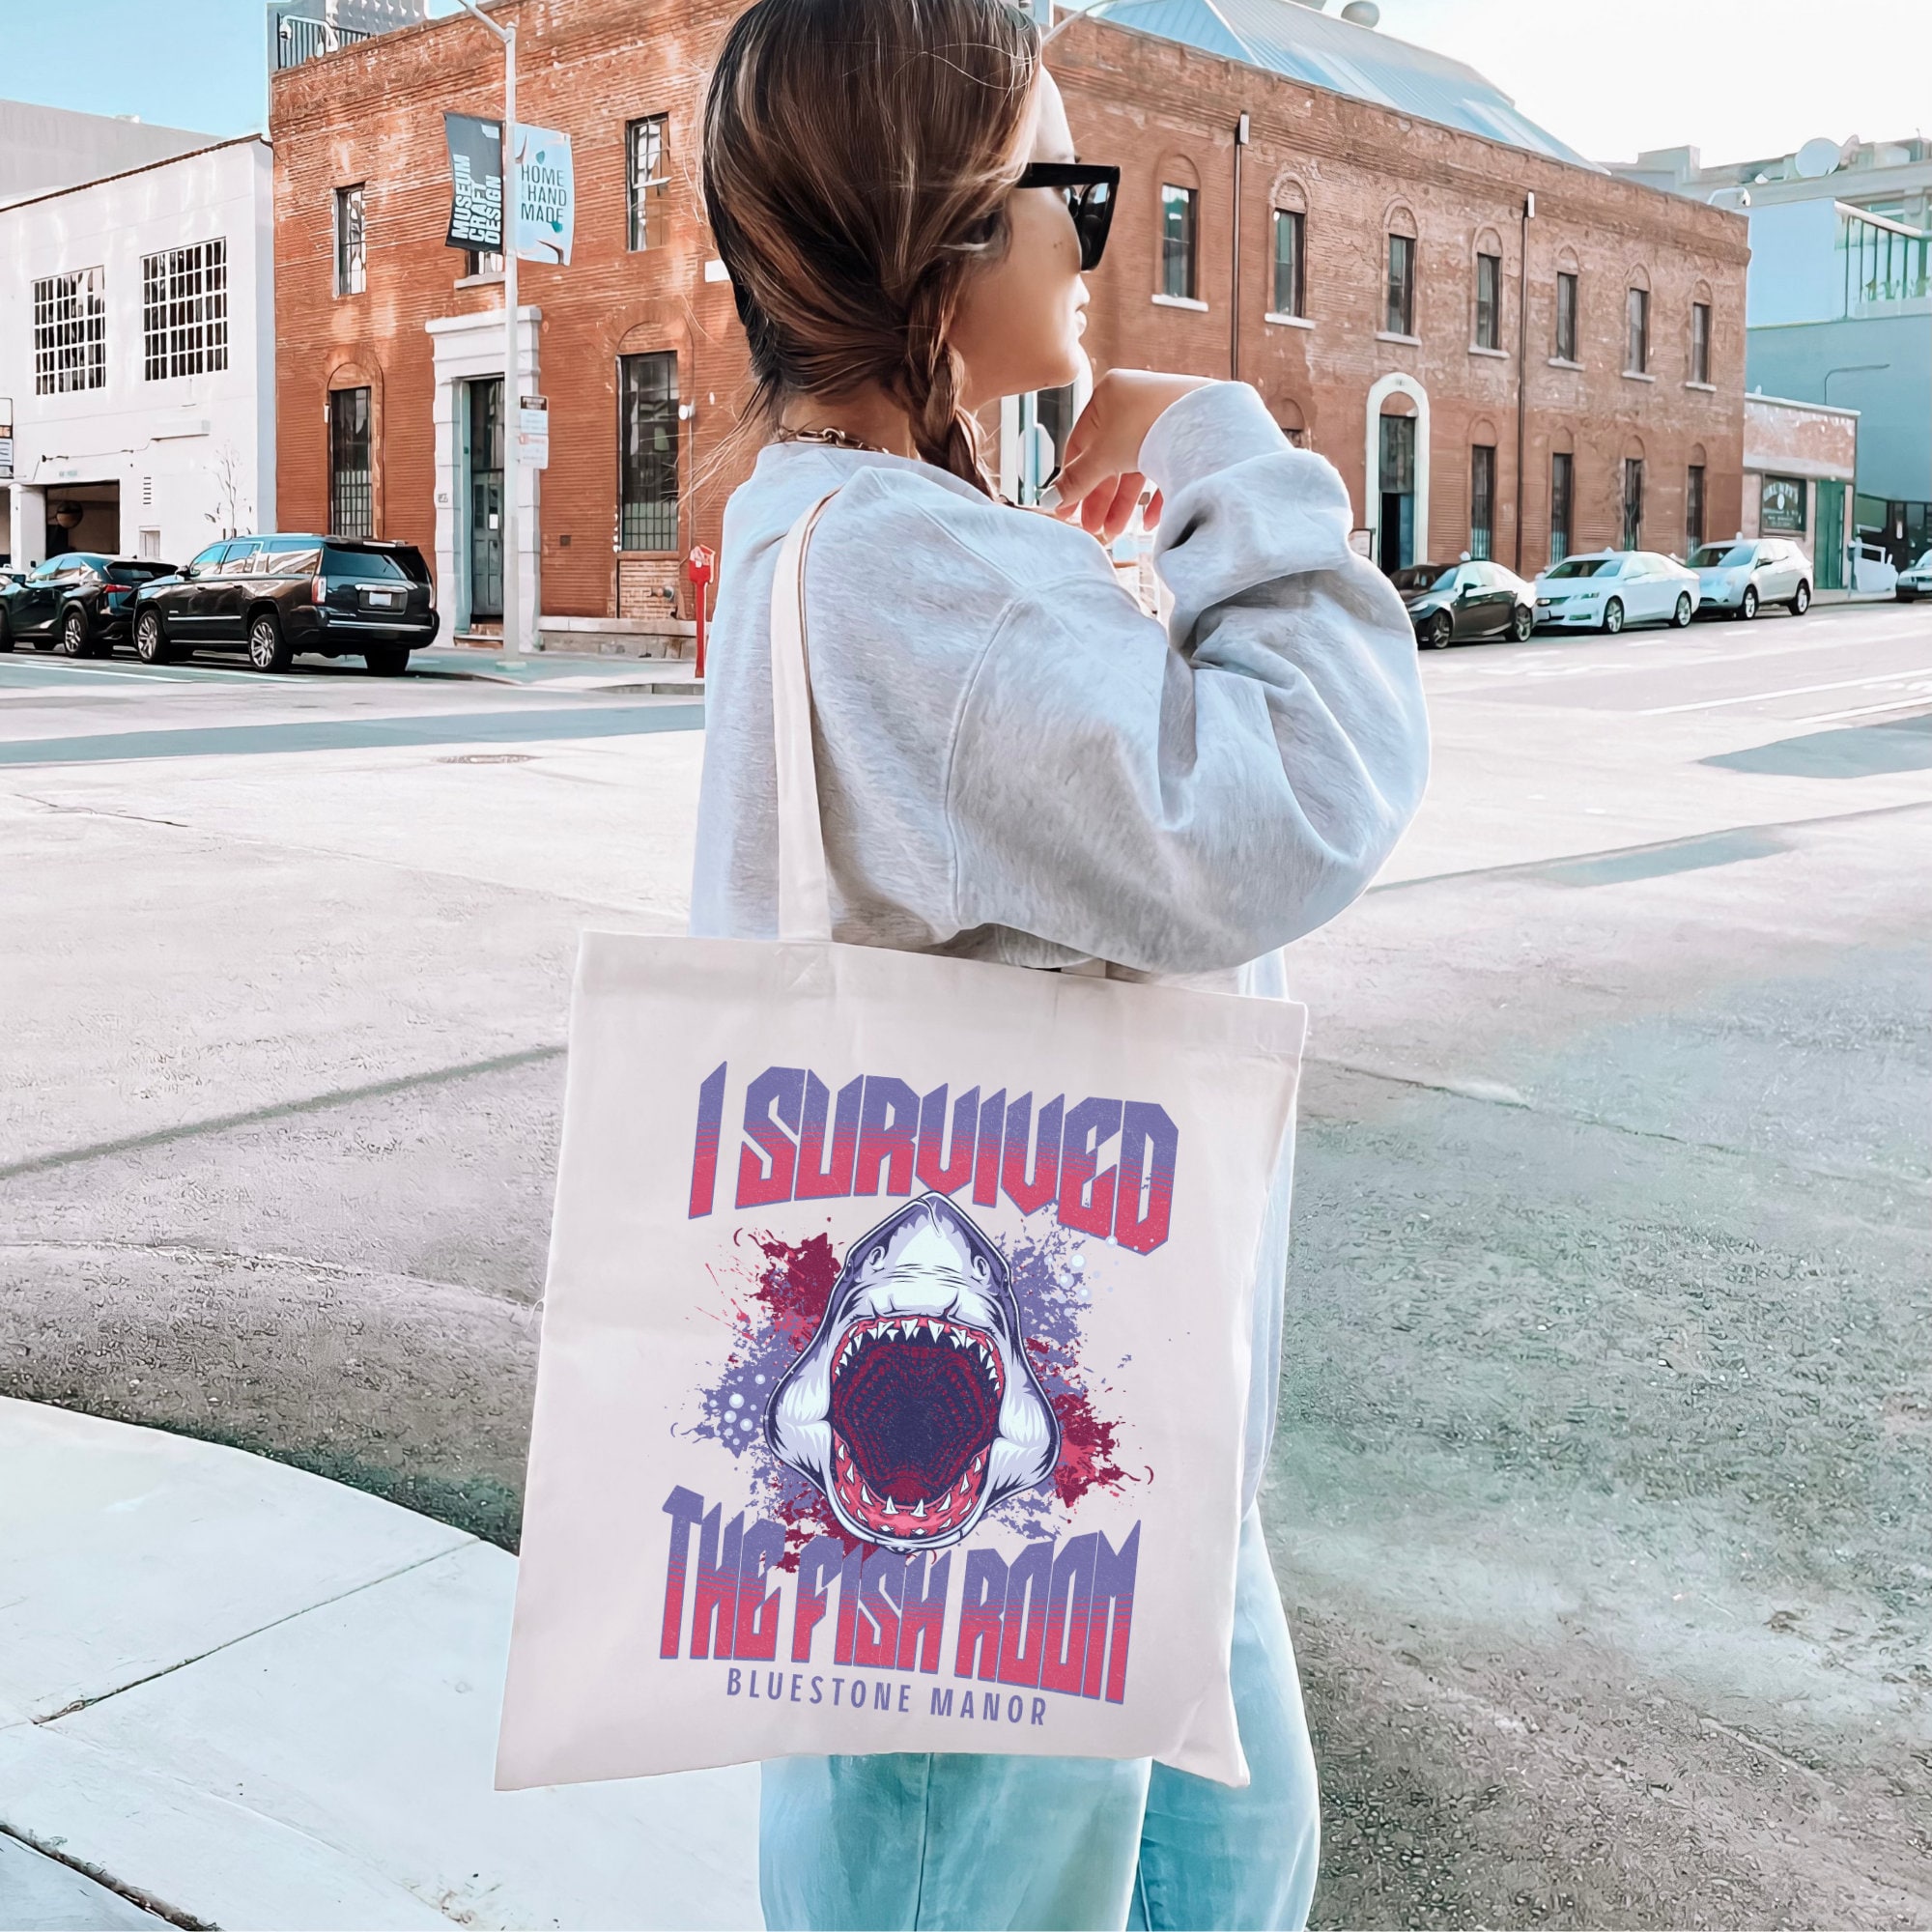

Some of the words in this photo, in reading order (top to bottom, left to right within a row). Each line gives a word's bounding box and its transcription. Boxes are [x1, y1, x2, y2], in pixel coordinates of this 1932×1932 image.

[451, 154, 471, 240] MUSEUM
[522, 164, 564, 186] HOME
[527, 185, 567, 206] HAND
[469, 179, 486, 242] CRAFT
[484, 175, 502, 244] DESIGN
[522, 203, 563, 223] MADE
[689, 1061, 727, 1219] I
[735, 1065, 1179, 1256] SURVIVED
[660, 1485, 787, 1662] THE
[791, 1535, 952, 1675] FISH
[954, 1520, 1141, 1704] ROOM
[727, 1667, 911, 1713] BLUESTONE
[930, 1687, 1046, 1725] MANOR
